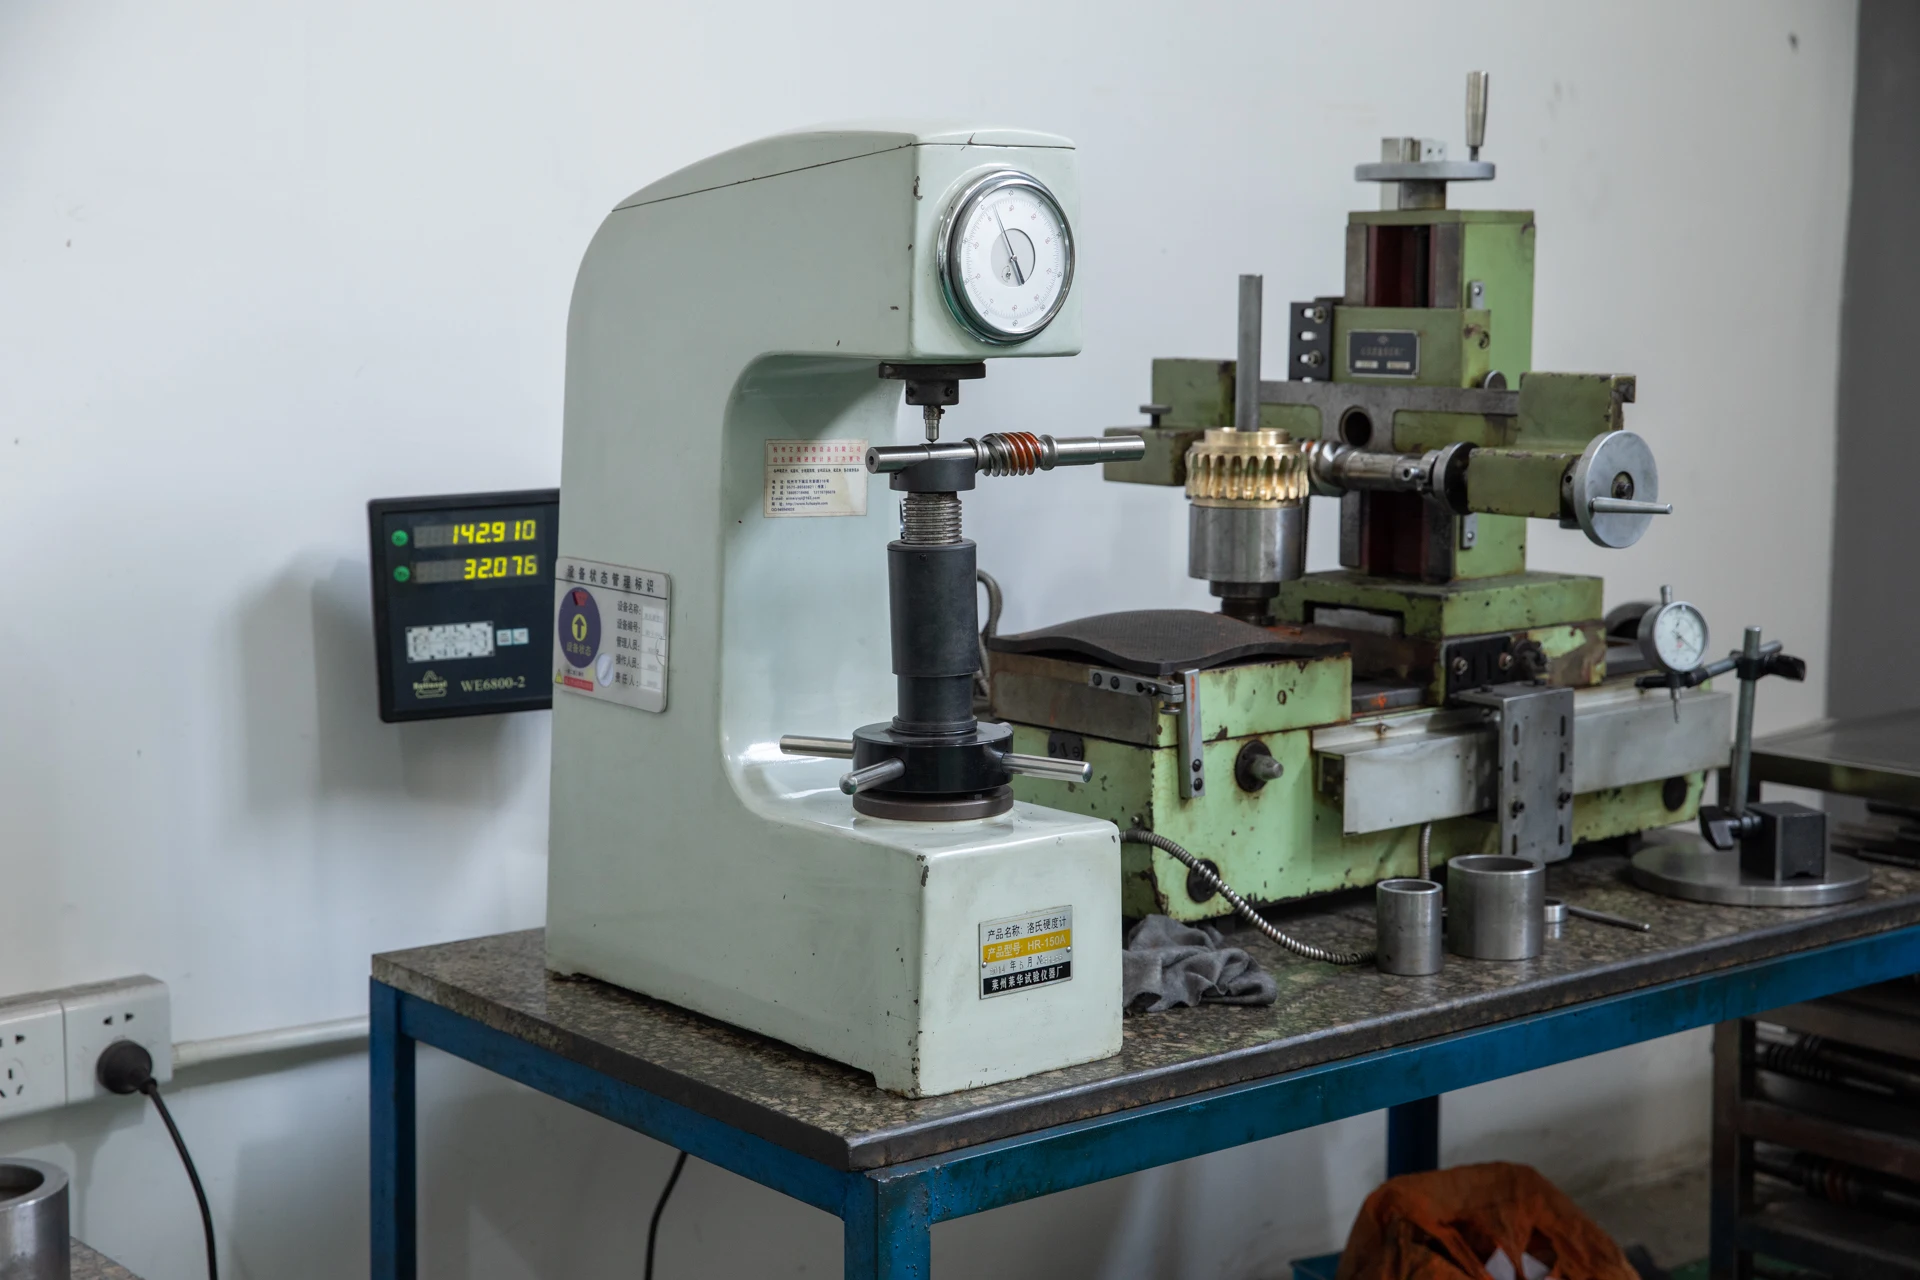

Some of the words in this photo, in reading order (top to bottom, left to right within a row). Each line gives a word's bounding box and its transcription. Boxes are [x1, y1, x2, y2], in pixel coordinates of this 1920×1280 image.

[566, 565, 654, 593] 设备状态管理标识
[460, 676, 526, 692] WE6800-2
[1027, 916, 1067, 934] 洛氏硬度计
[1027, 934, 1066, 951] HR-150A
